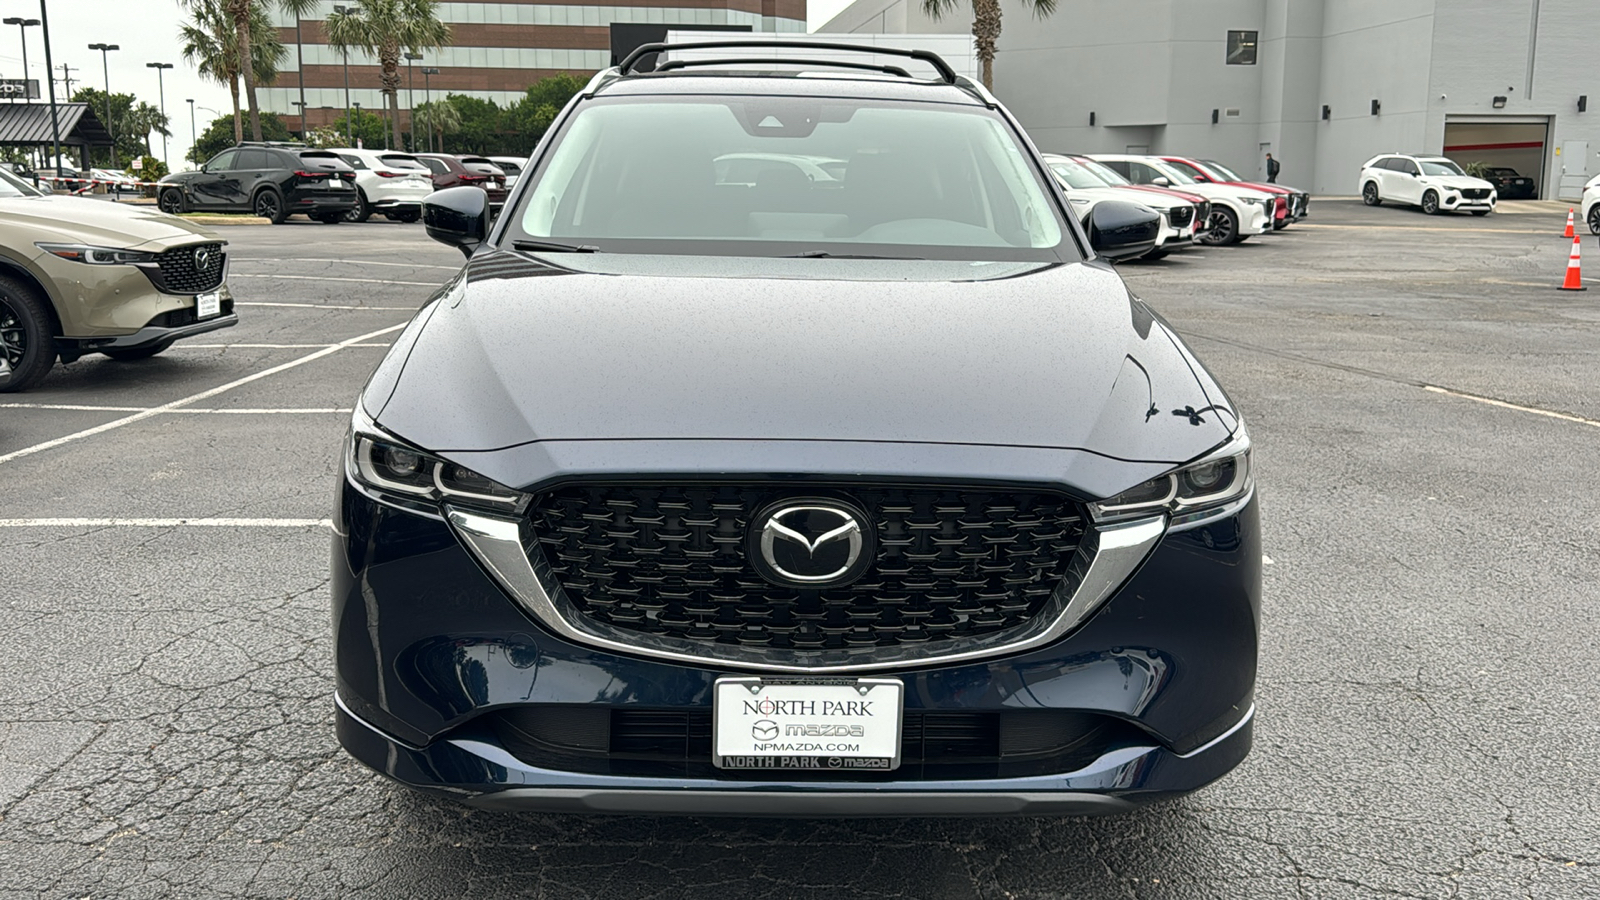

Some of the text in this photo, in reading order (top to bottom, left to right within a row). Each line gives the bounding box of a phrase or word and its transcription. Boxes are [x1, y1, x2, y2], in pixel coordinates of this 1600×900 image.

[743, 699, 874, 717] NORTH PARK
[785, 724, 864, 738] mazda
[754, 743, 860, 752] NPMAZDA.COM
[725, 756, 889, 768] NORTH PARK mazda
